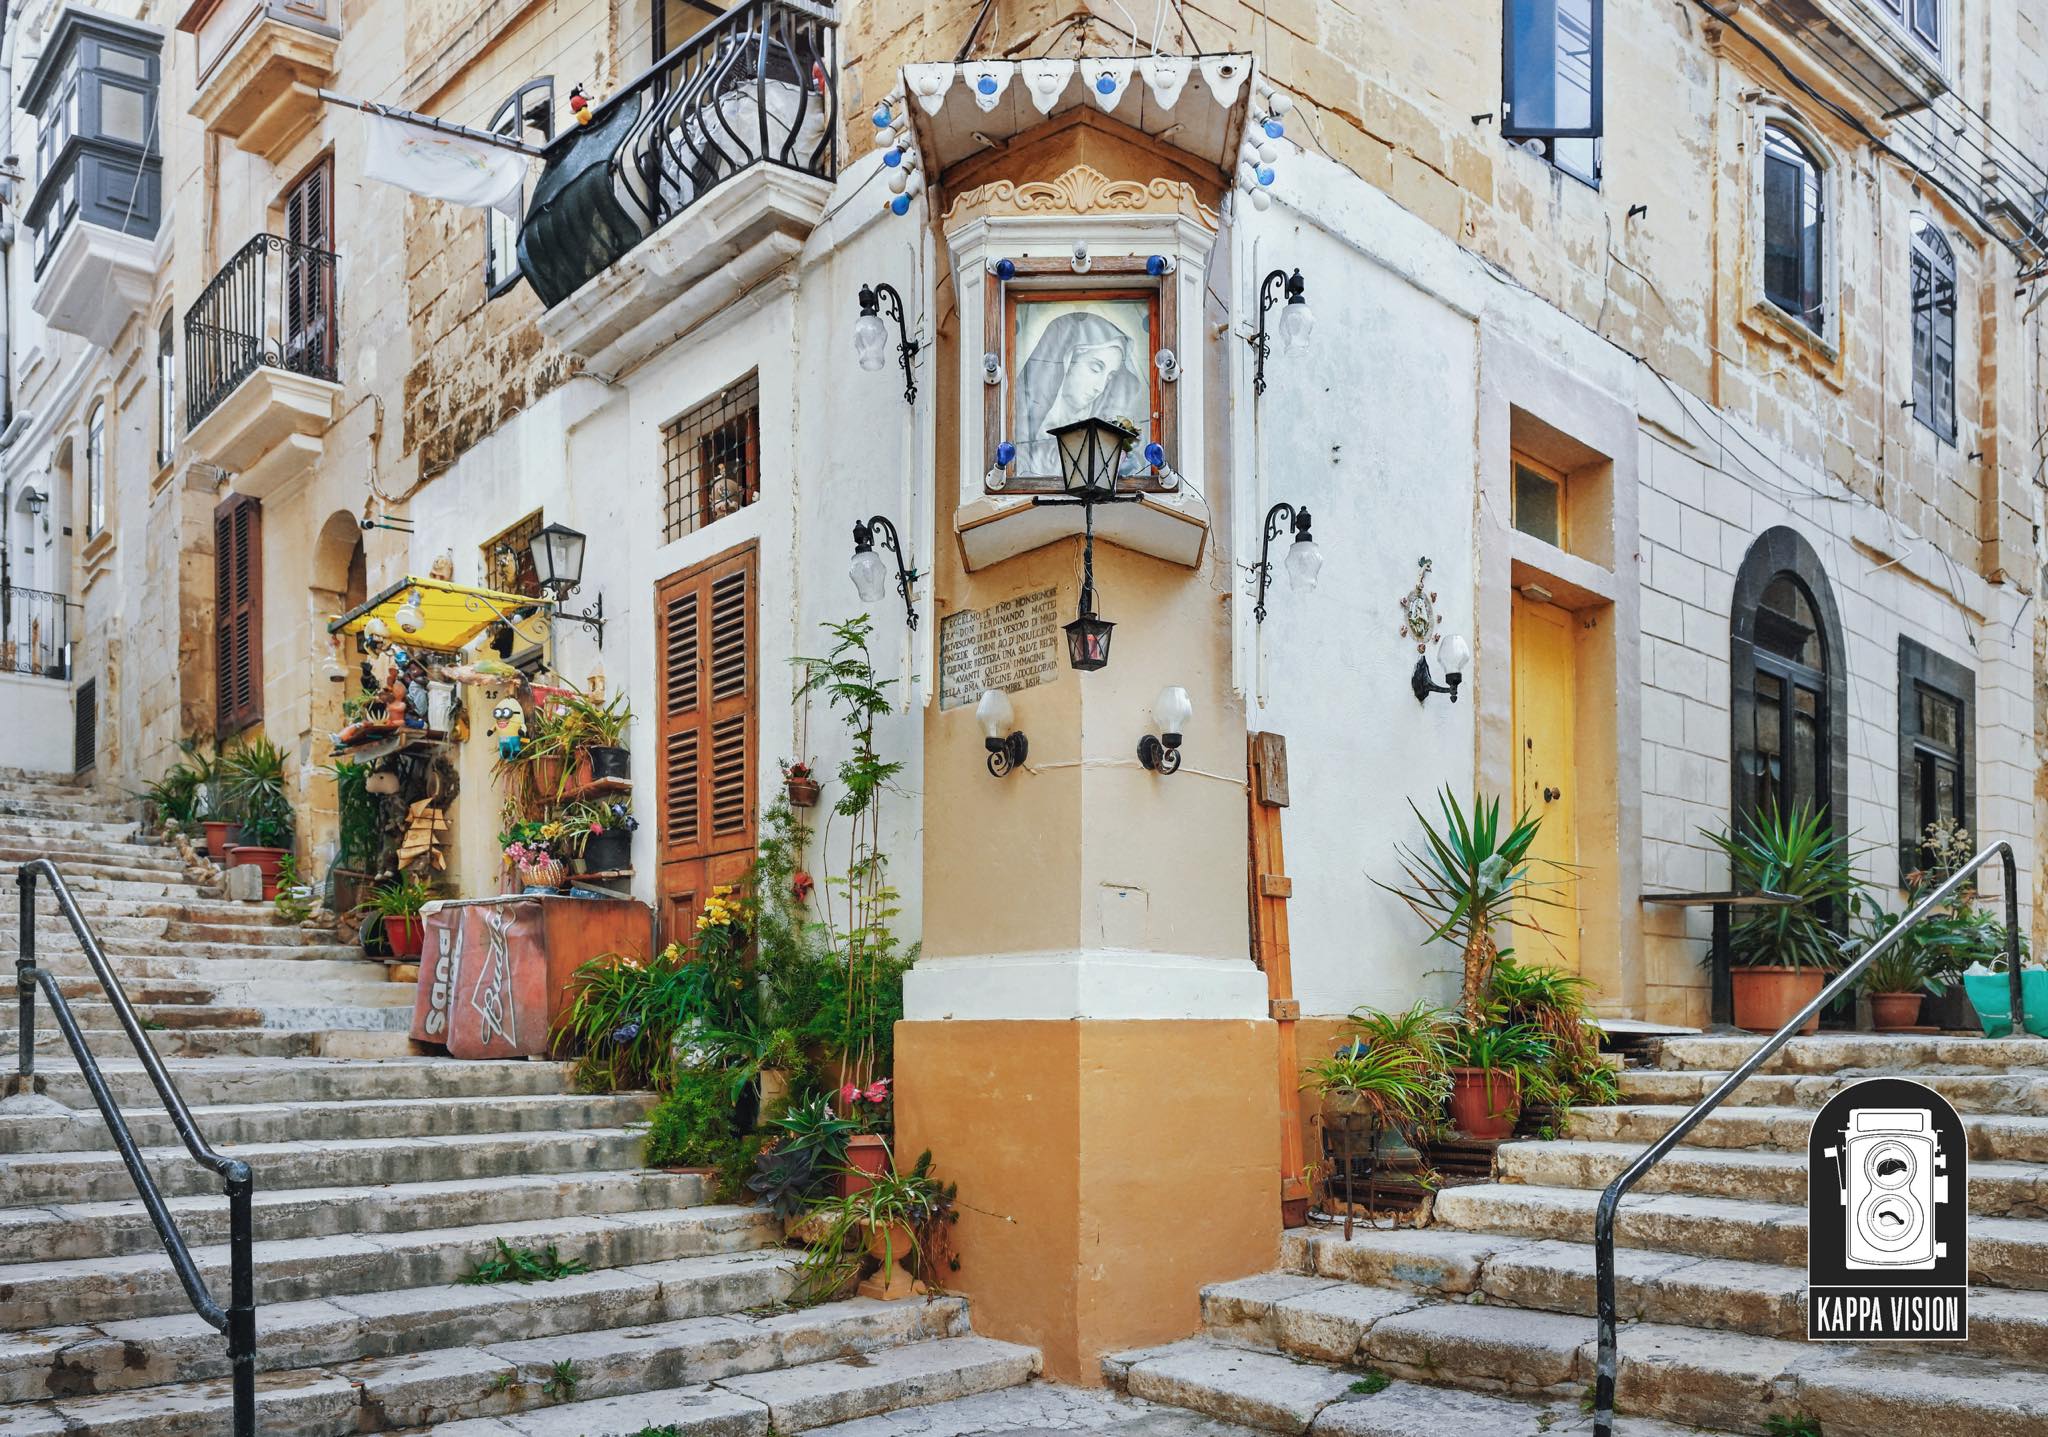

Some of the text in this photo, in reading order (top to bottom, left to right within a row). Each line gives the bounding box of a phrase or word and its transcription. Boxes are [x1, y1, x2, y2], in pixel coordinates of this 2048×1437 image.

[959, 624, 975, 638] DON
[1018, 641, 1038, 655] SALVE
[955, 669, 980, 684] AVANTI
[981, 672, 1012, 688] VERGINE
[485, 690, 499, 700] 25
[425, 928, 451, 1035] BUDS
